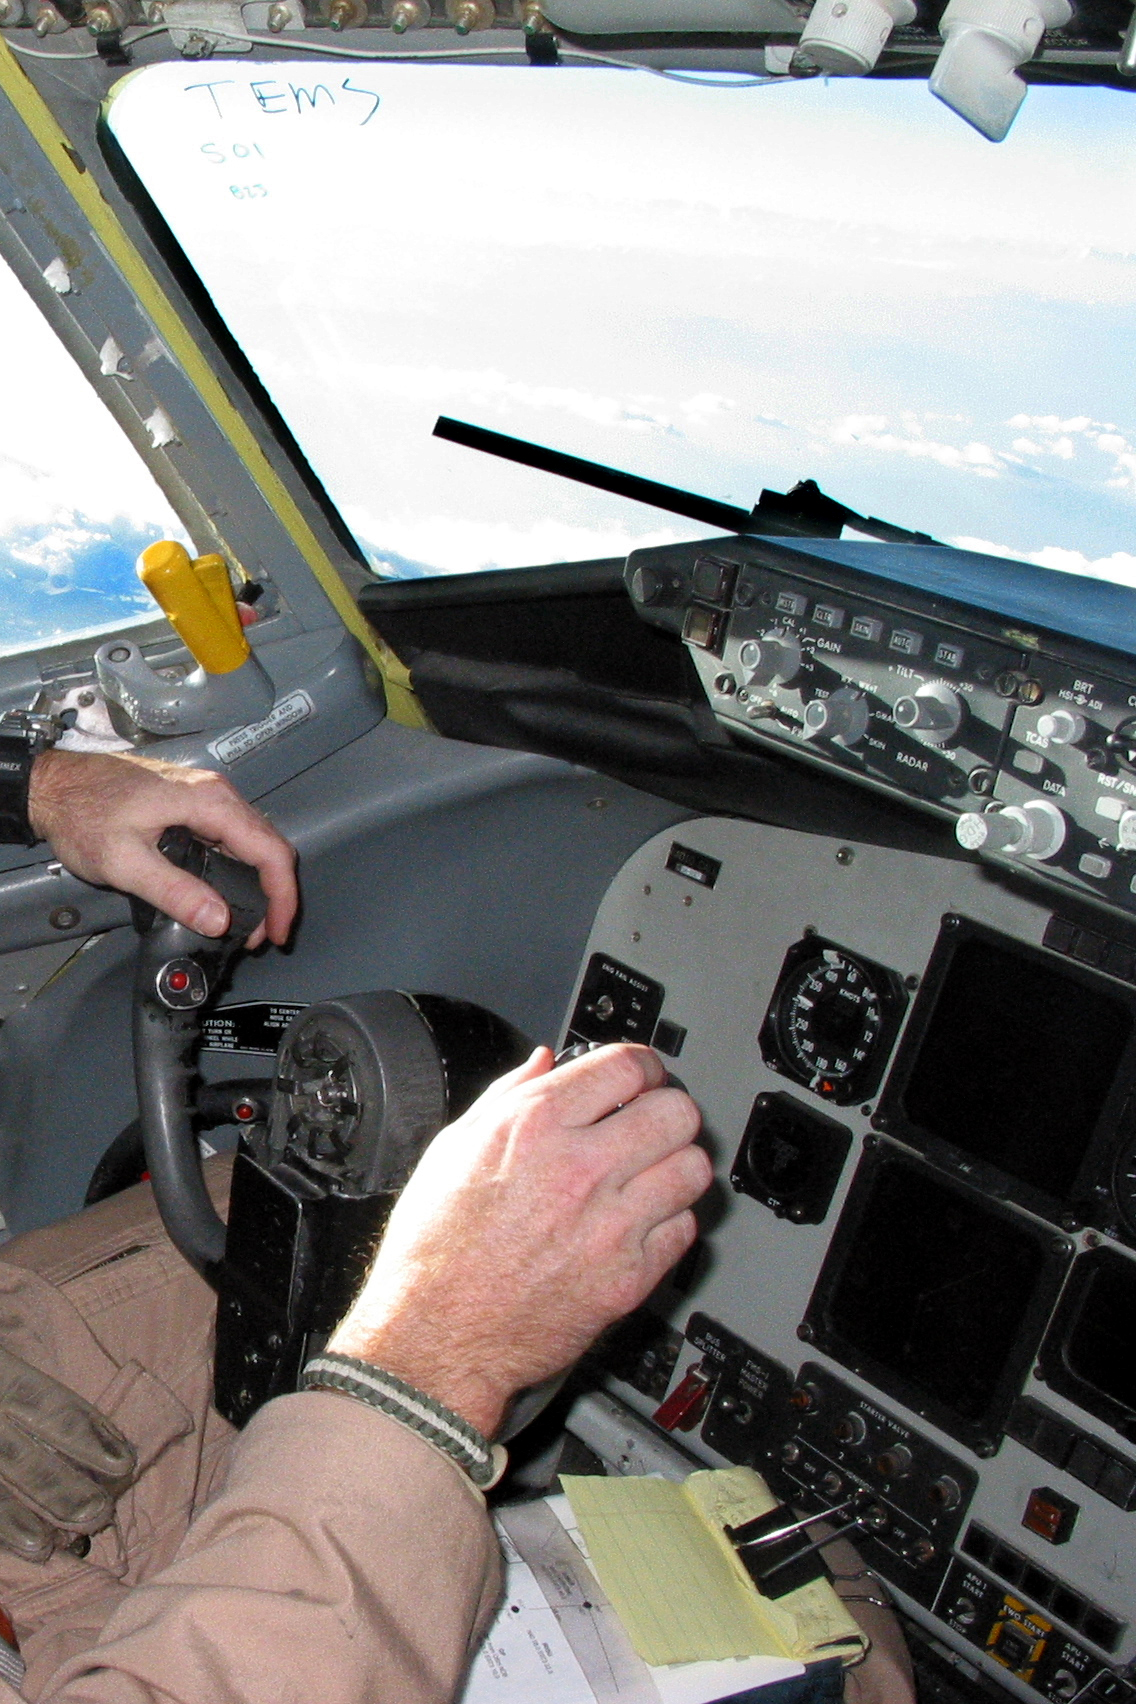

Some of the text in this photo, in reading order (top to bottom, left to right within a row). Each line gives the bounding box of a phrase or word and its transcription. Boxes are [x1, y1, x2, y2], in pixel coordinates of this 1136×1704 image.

[816, 638, 842, 653] GAIN
[896, 664, 915, 679] TILT
[1073, 680, 1095, 695] BRT
[1058, 689, 1104, 711] HSI ADI
[278, 703, 293, 716] AND
[1025, 730, 1049, 749] TCAS
[895, 752, 929, 772] RADAR
[1042, 779, 1066, 798] DATA
